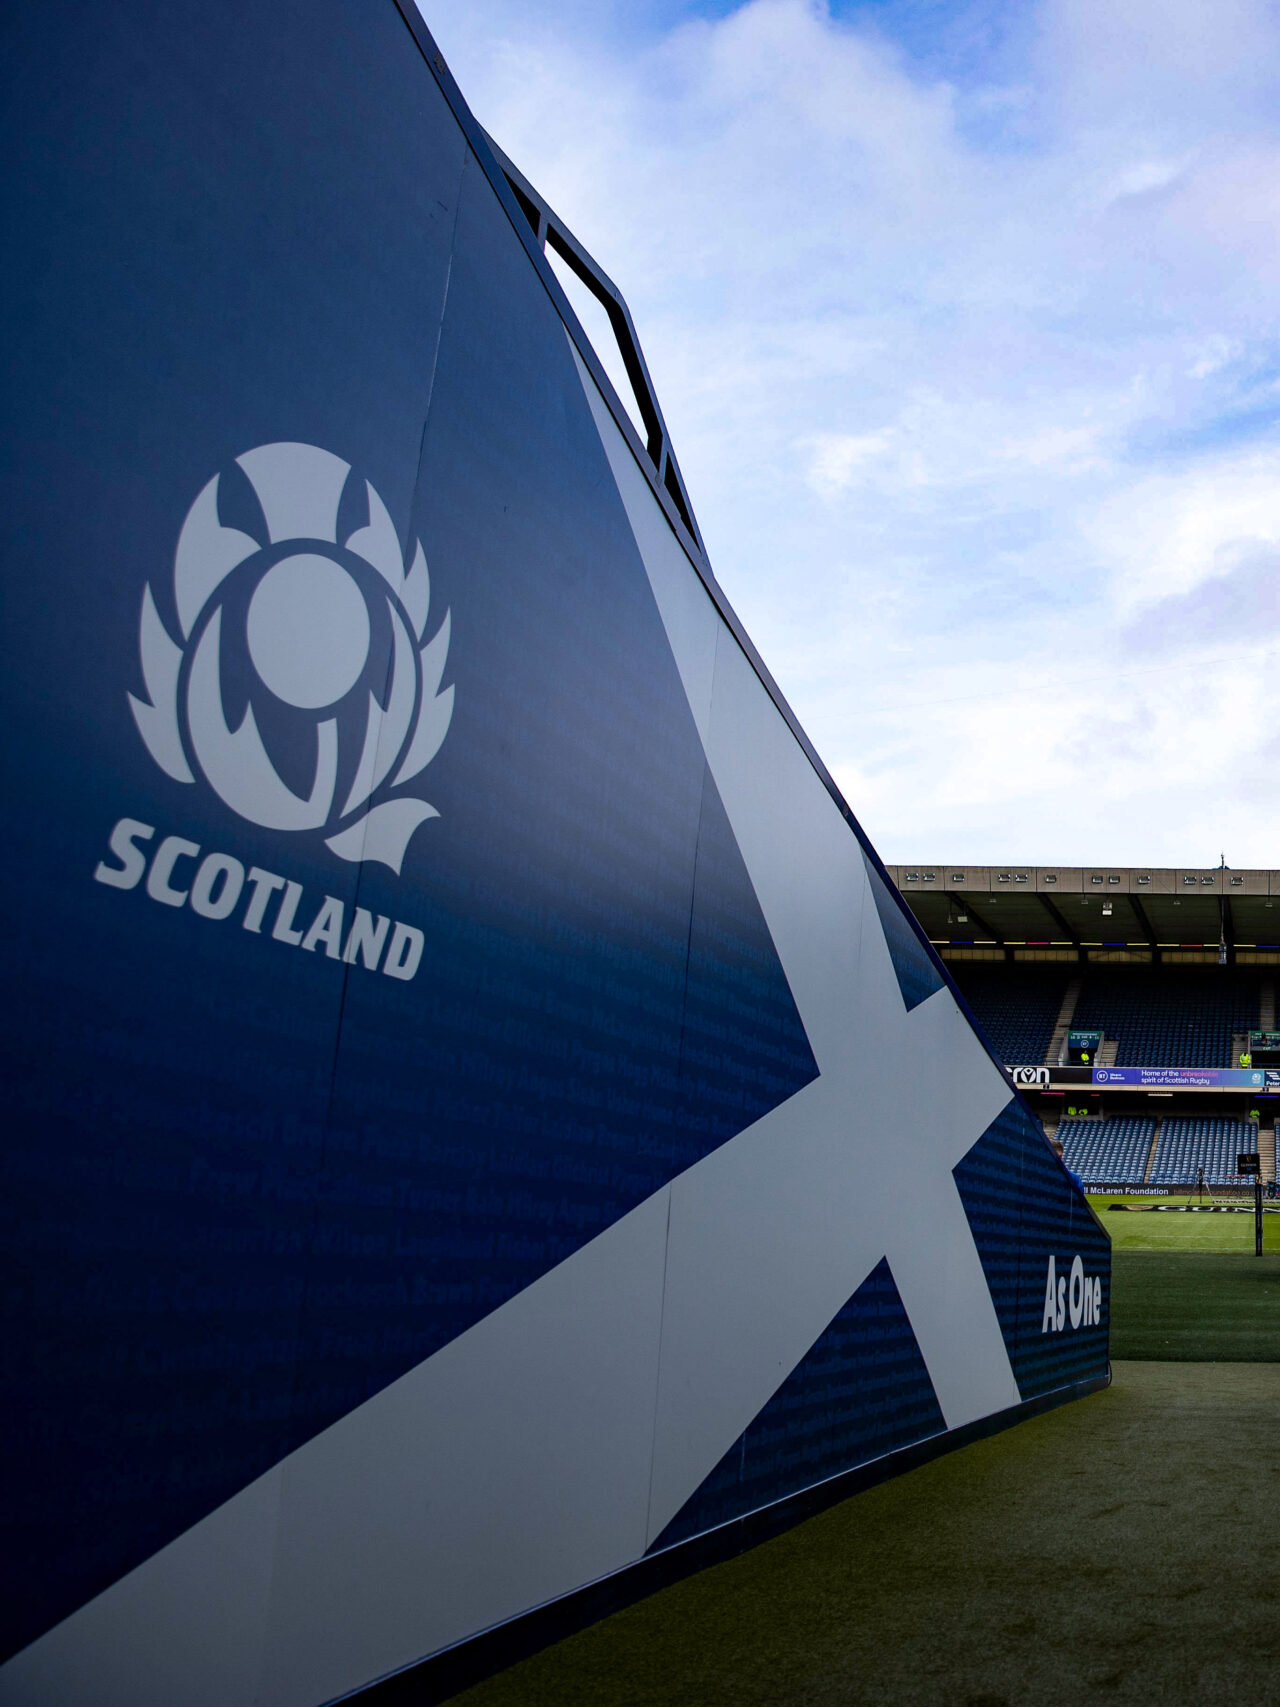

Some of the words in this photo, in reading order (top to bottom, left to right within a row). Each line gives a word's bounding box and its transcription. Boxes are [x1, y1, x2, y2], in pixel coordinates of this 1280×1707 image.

[94, 817, 425, 981] SCOTLAND
[1141, 1077, 1156, 1085] spirit
[1190, 1078, 1210, 1086] Rugby
[1090, 1186, 1123, 1194] McLaren
[1125, 1187, 1169, 1195] Foundation
[1042, 1254, 1067, 1333] As
[1069, 1254, 1102, 1330] One
